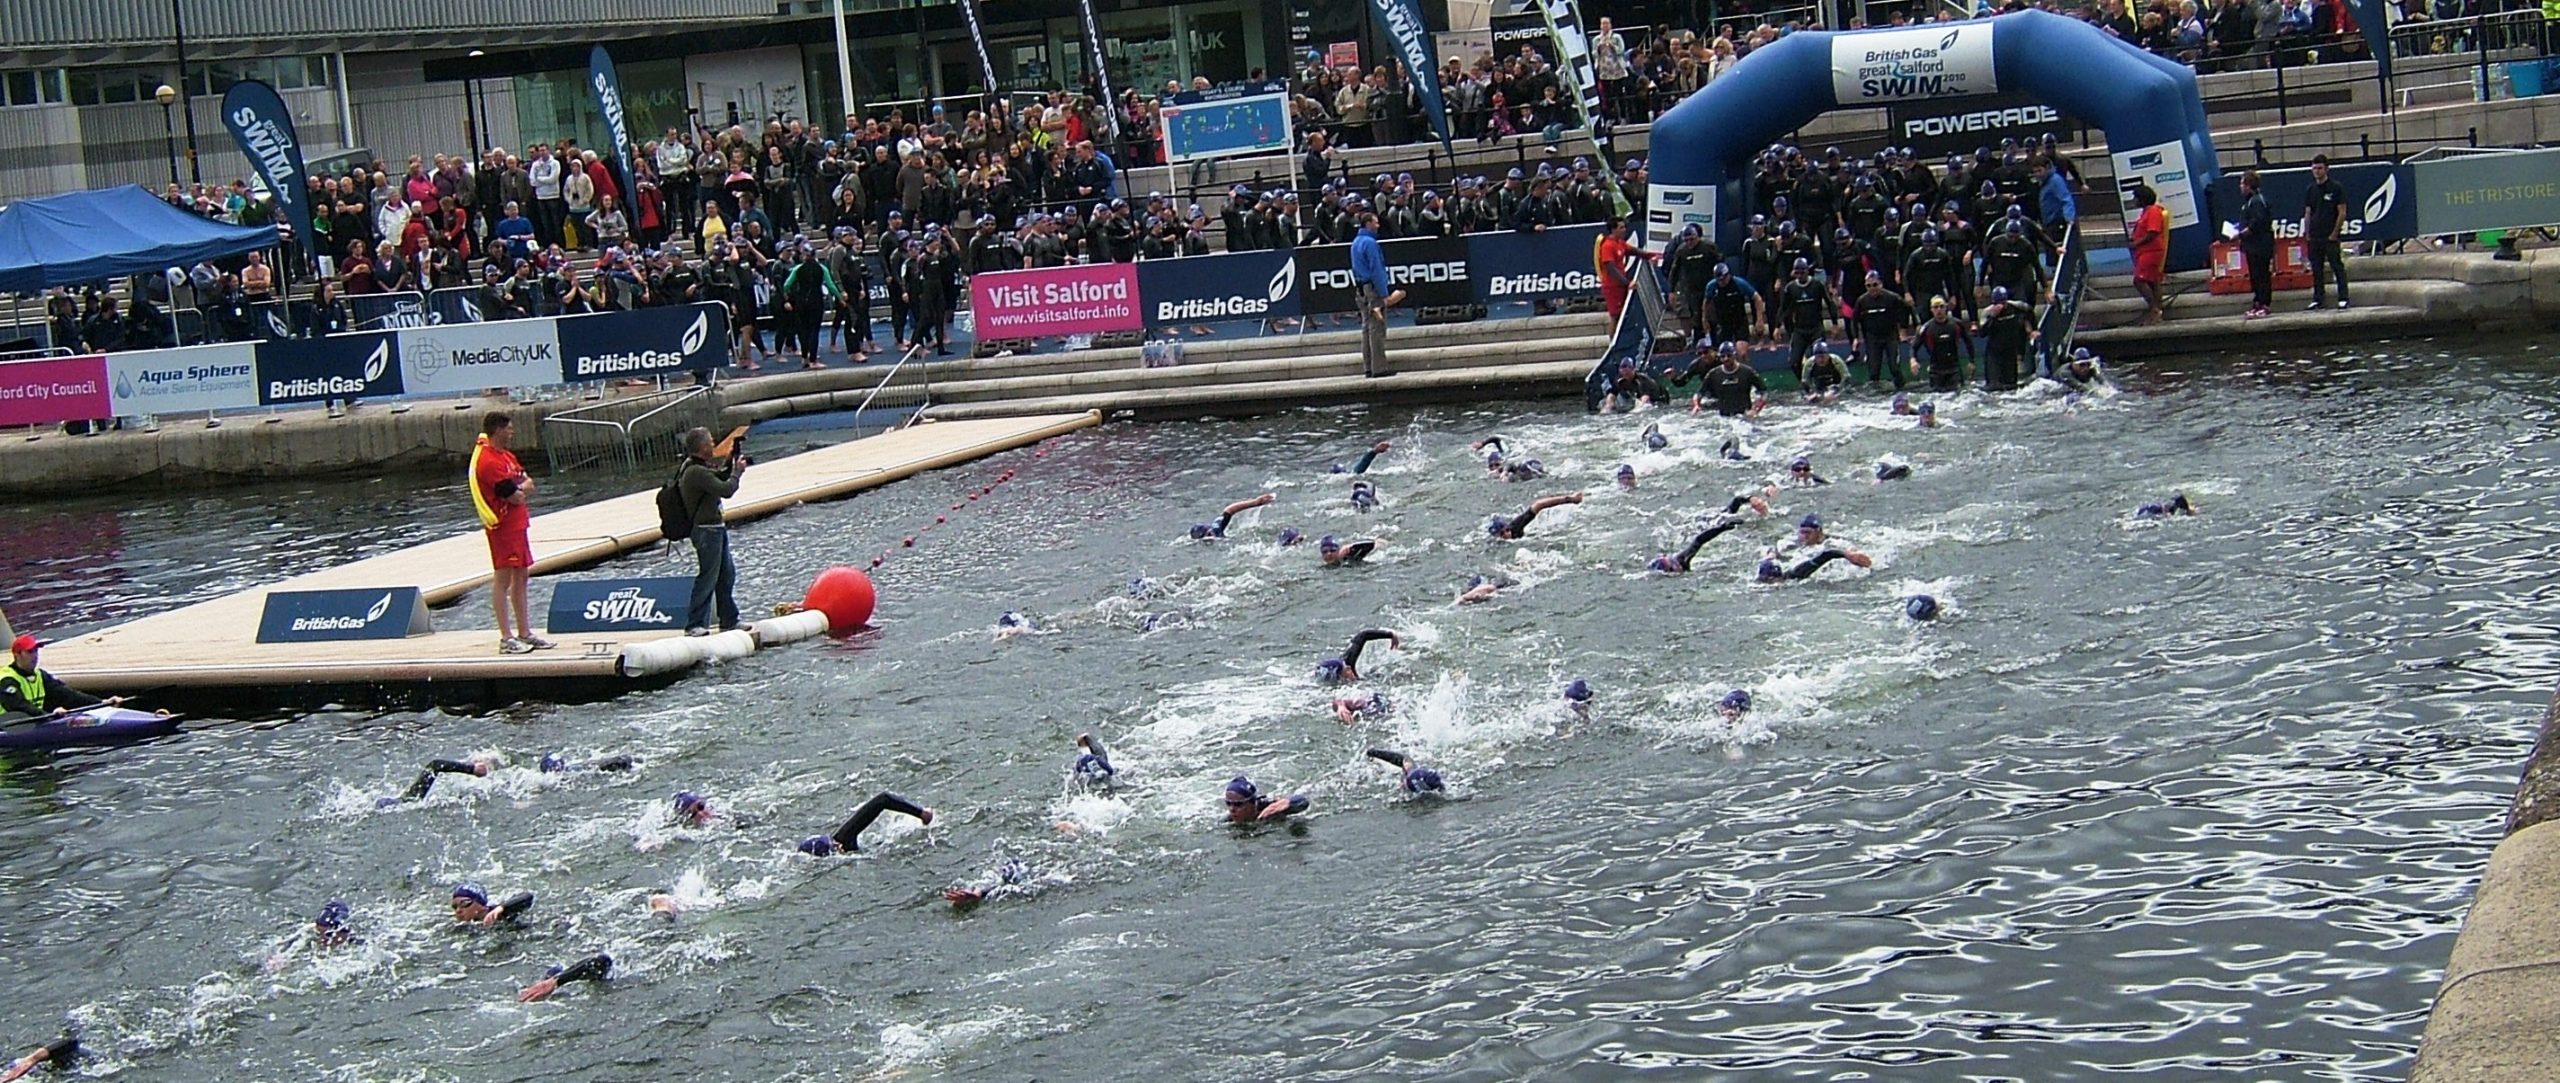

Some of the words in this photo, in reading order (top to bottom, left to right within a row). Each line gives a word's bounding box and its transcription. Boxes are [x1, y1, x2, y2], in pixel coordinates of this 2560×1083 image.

[1494, 27, 1550, 43] POWERA
[1865, 49, 1910, 62] British
[1912, 48, 1938, 59] Gas
[1859, 63, 1891, 80] great
[1900, 60, 1944, 74] salford
[1862, 75, 1942, 97] SWIM
[1943, 73, 1966, 82] 2010
[1904, 105, 2060, 138] POWERADE
[233, 107, 294, 180] SWIM
[2444, 190, 2474, 205] THE
[2504, 183, 2556, 201] STORE
[1310, 261, 1467, 290] PORADE
[988, 284, 1040, 308] Visit
[1044, 278, 1127, 304] Salford
[991, 304, 1130, 326] www.visitsalford.info
[1157, 295, 1268, 320] BritishGas
[452, 343, 552, 367] MediaCityUK
[577, 350, 682, 375] BritishGas
[138, 370, 183, 385] Aqua
[187, 364, 250, 381] Sphere
[26, 384, 49, 400] City
[52, 380, 97, 396] Council
[270, 376, 365, 399] BritishGas
[583, 599, 656, 621] SWIM
[292, 615, 366, 632] BritishGas
